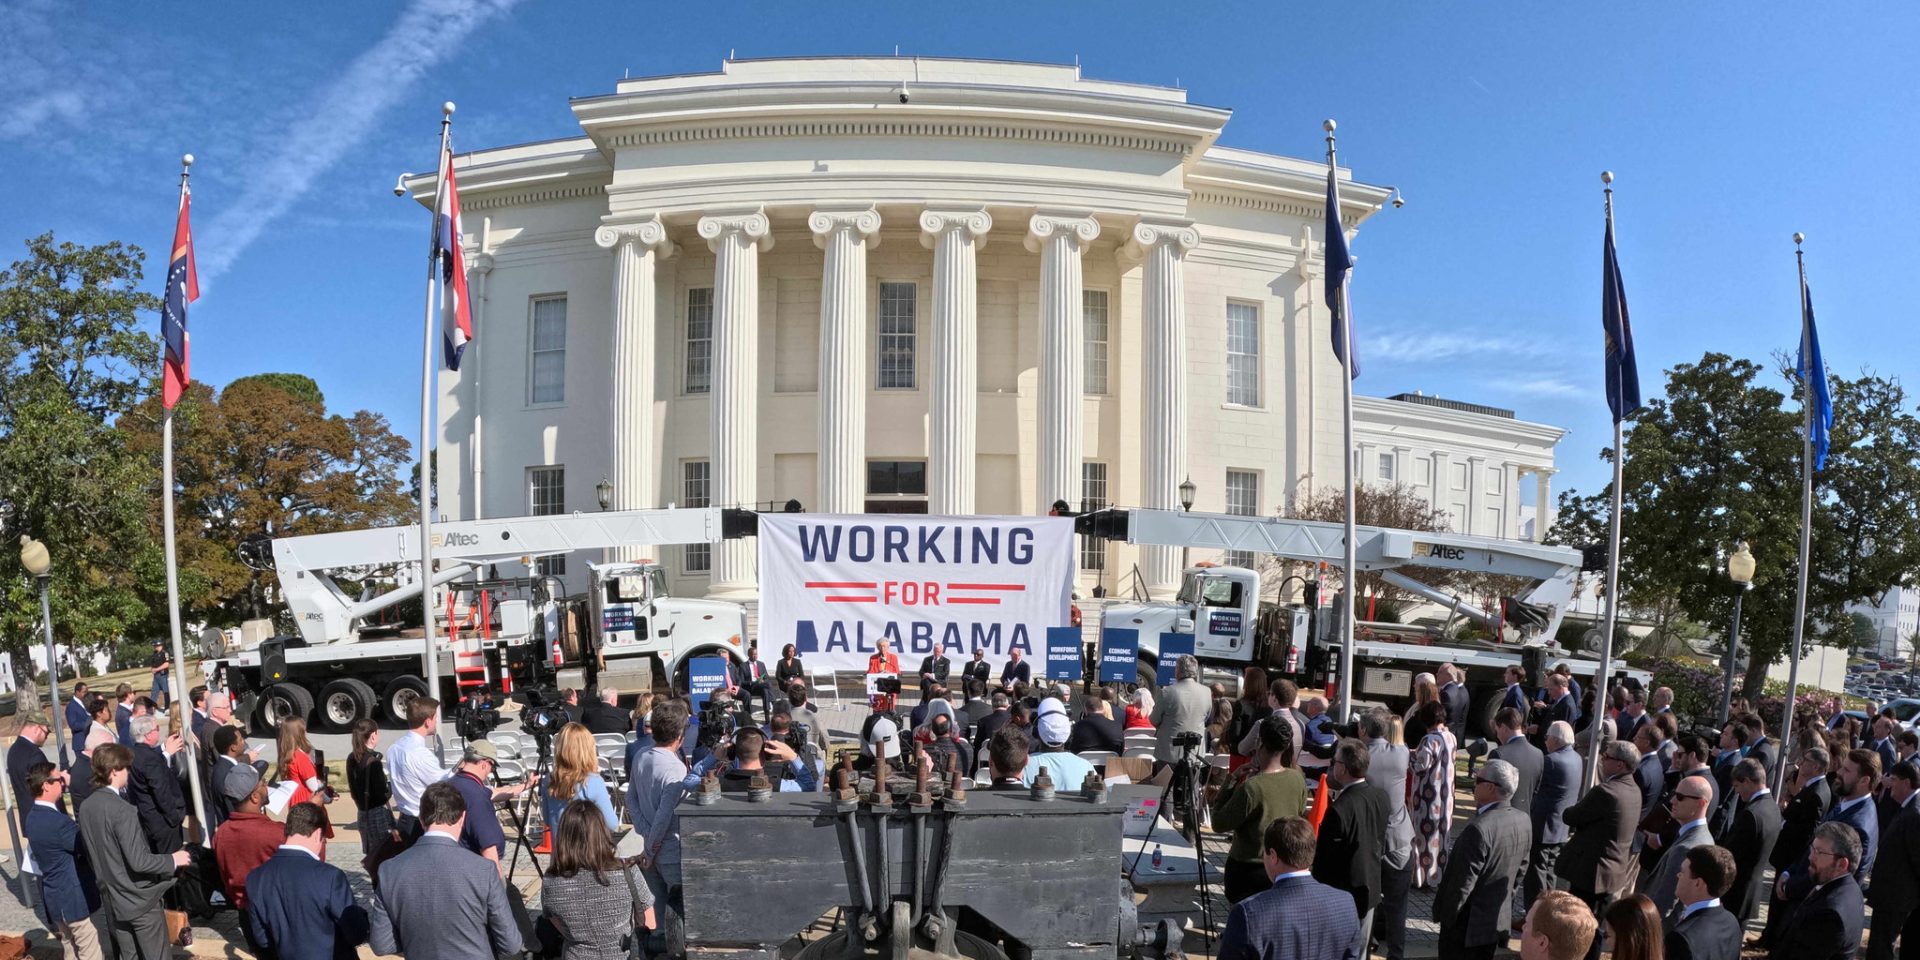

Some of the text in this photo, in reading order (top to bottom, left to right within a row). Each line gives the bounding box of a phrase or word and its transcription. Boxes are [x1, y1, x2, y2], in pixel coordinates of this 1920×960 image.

[444, 532, 478, 547] Altec
[798, 524, 1034, 565] WORKING
[1430, 544, 1464, 560] Altec
[884, 581, 940, 606] FOR
[305, 612, 324, 620] Altec
[825, 620, 1033, 656] ALABAMA
[1108, 647, 1132, 655] ECONOMIC
[1103, 655, 1135, 663] DEVELOPMENT
